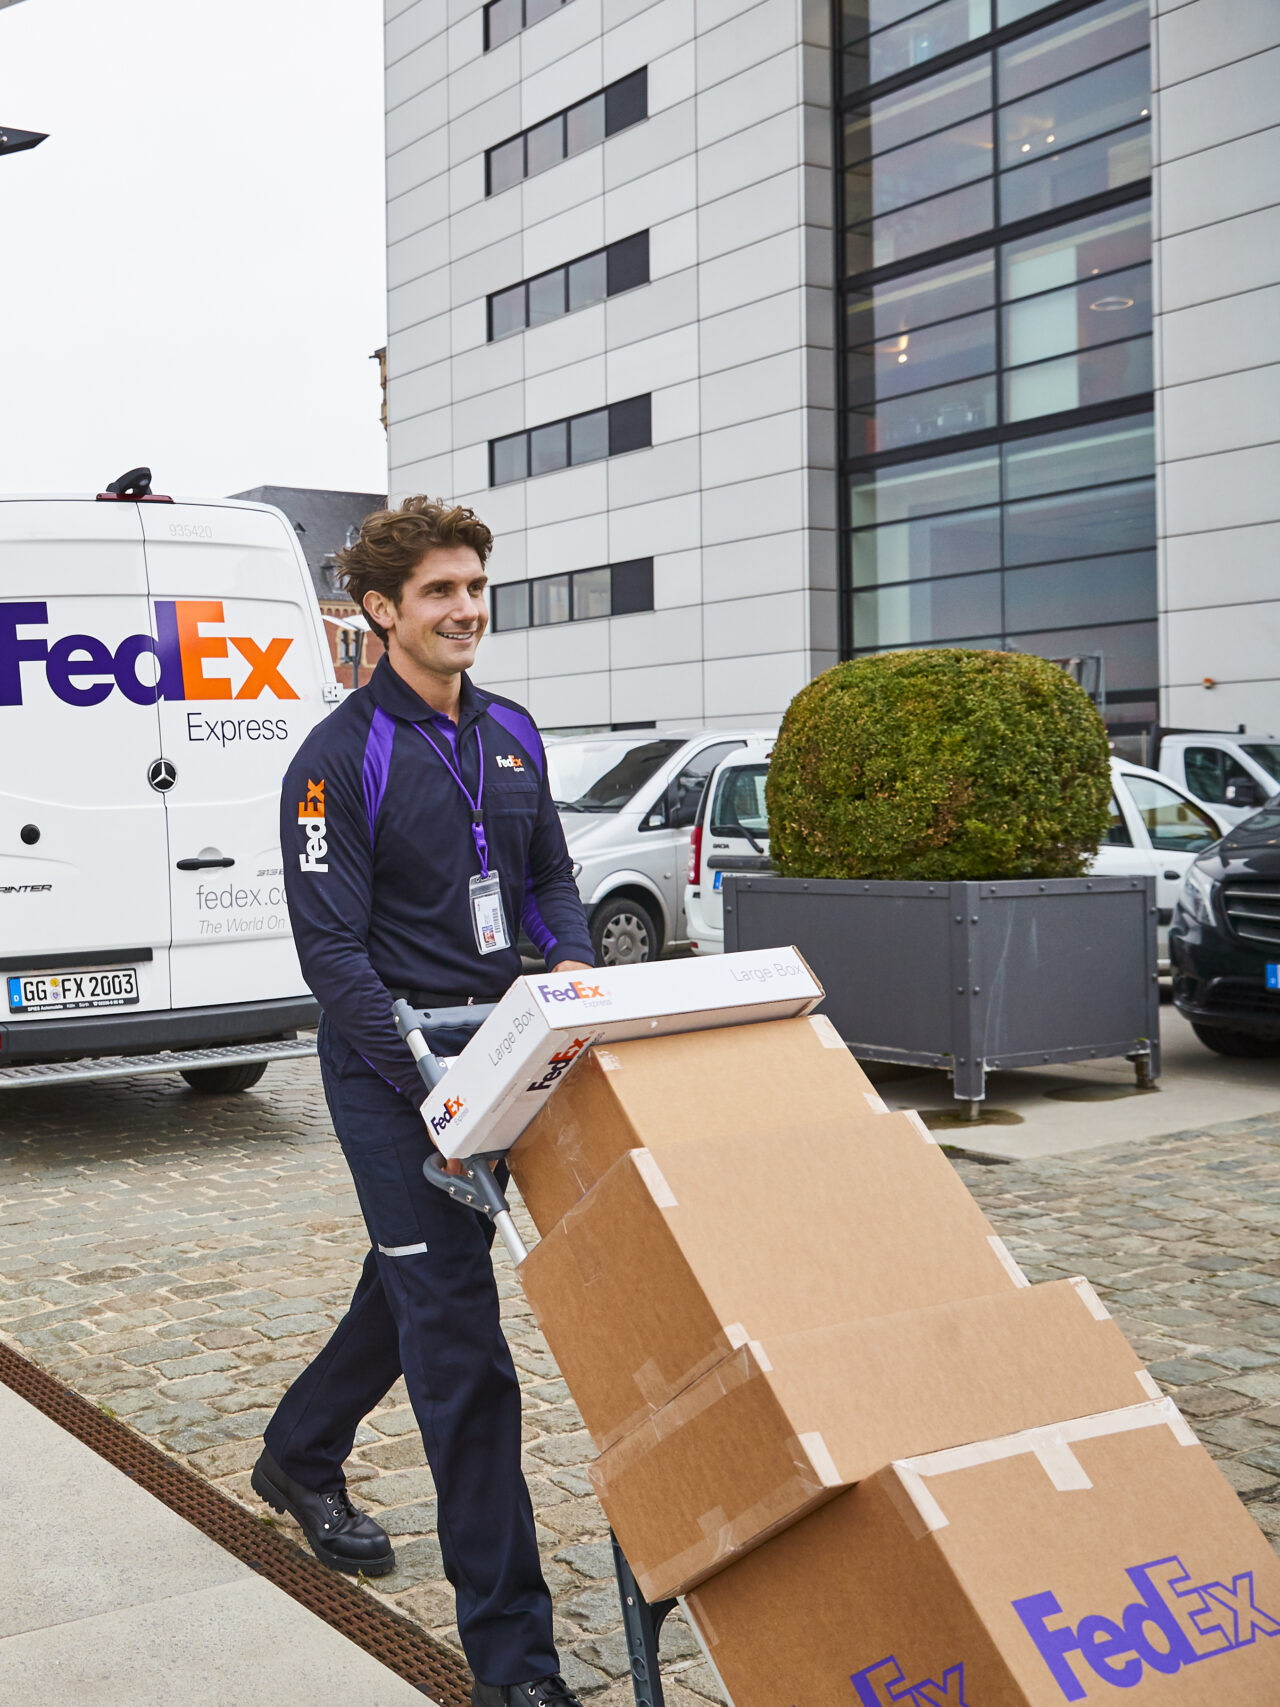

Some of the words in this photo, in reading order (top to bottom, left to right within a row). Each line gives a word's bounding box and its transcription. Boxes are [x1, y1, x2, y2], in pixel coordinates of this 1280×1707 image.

[168, 523, 213, 538] 935420
[187, 712, 288, 748] Express
[495, 754, 523, 768] FedEx
[298, 778, 329, 873] FedEx
[200, 920, 223, 934] The
[226, 916, 265, 933] World
[267, 915, 285, 930] On
[23, 981, 48, 1002] GG
[61, 977, 86, 999] FX
[89, 973, 134, 997] 2003
[729, 966, 775, 983] Large
[773, 963, 806, 978] Box
[538, 981, 605, 1003] FedEx
[488, 1031, 517, 1067] Large
[512, 1008, 536, 1035] Box
[526, 1034, 591, 1092] FedEx
[431, 1095, 464, 1136] FedEx
[1011, 1555, 1280, 1703] FedEx
